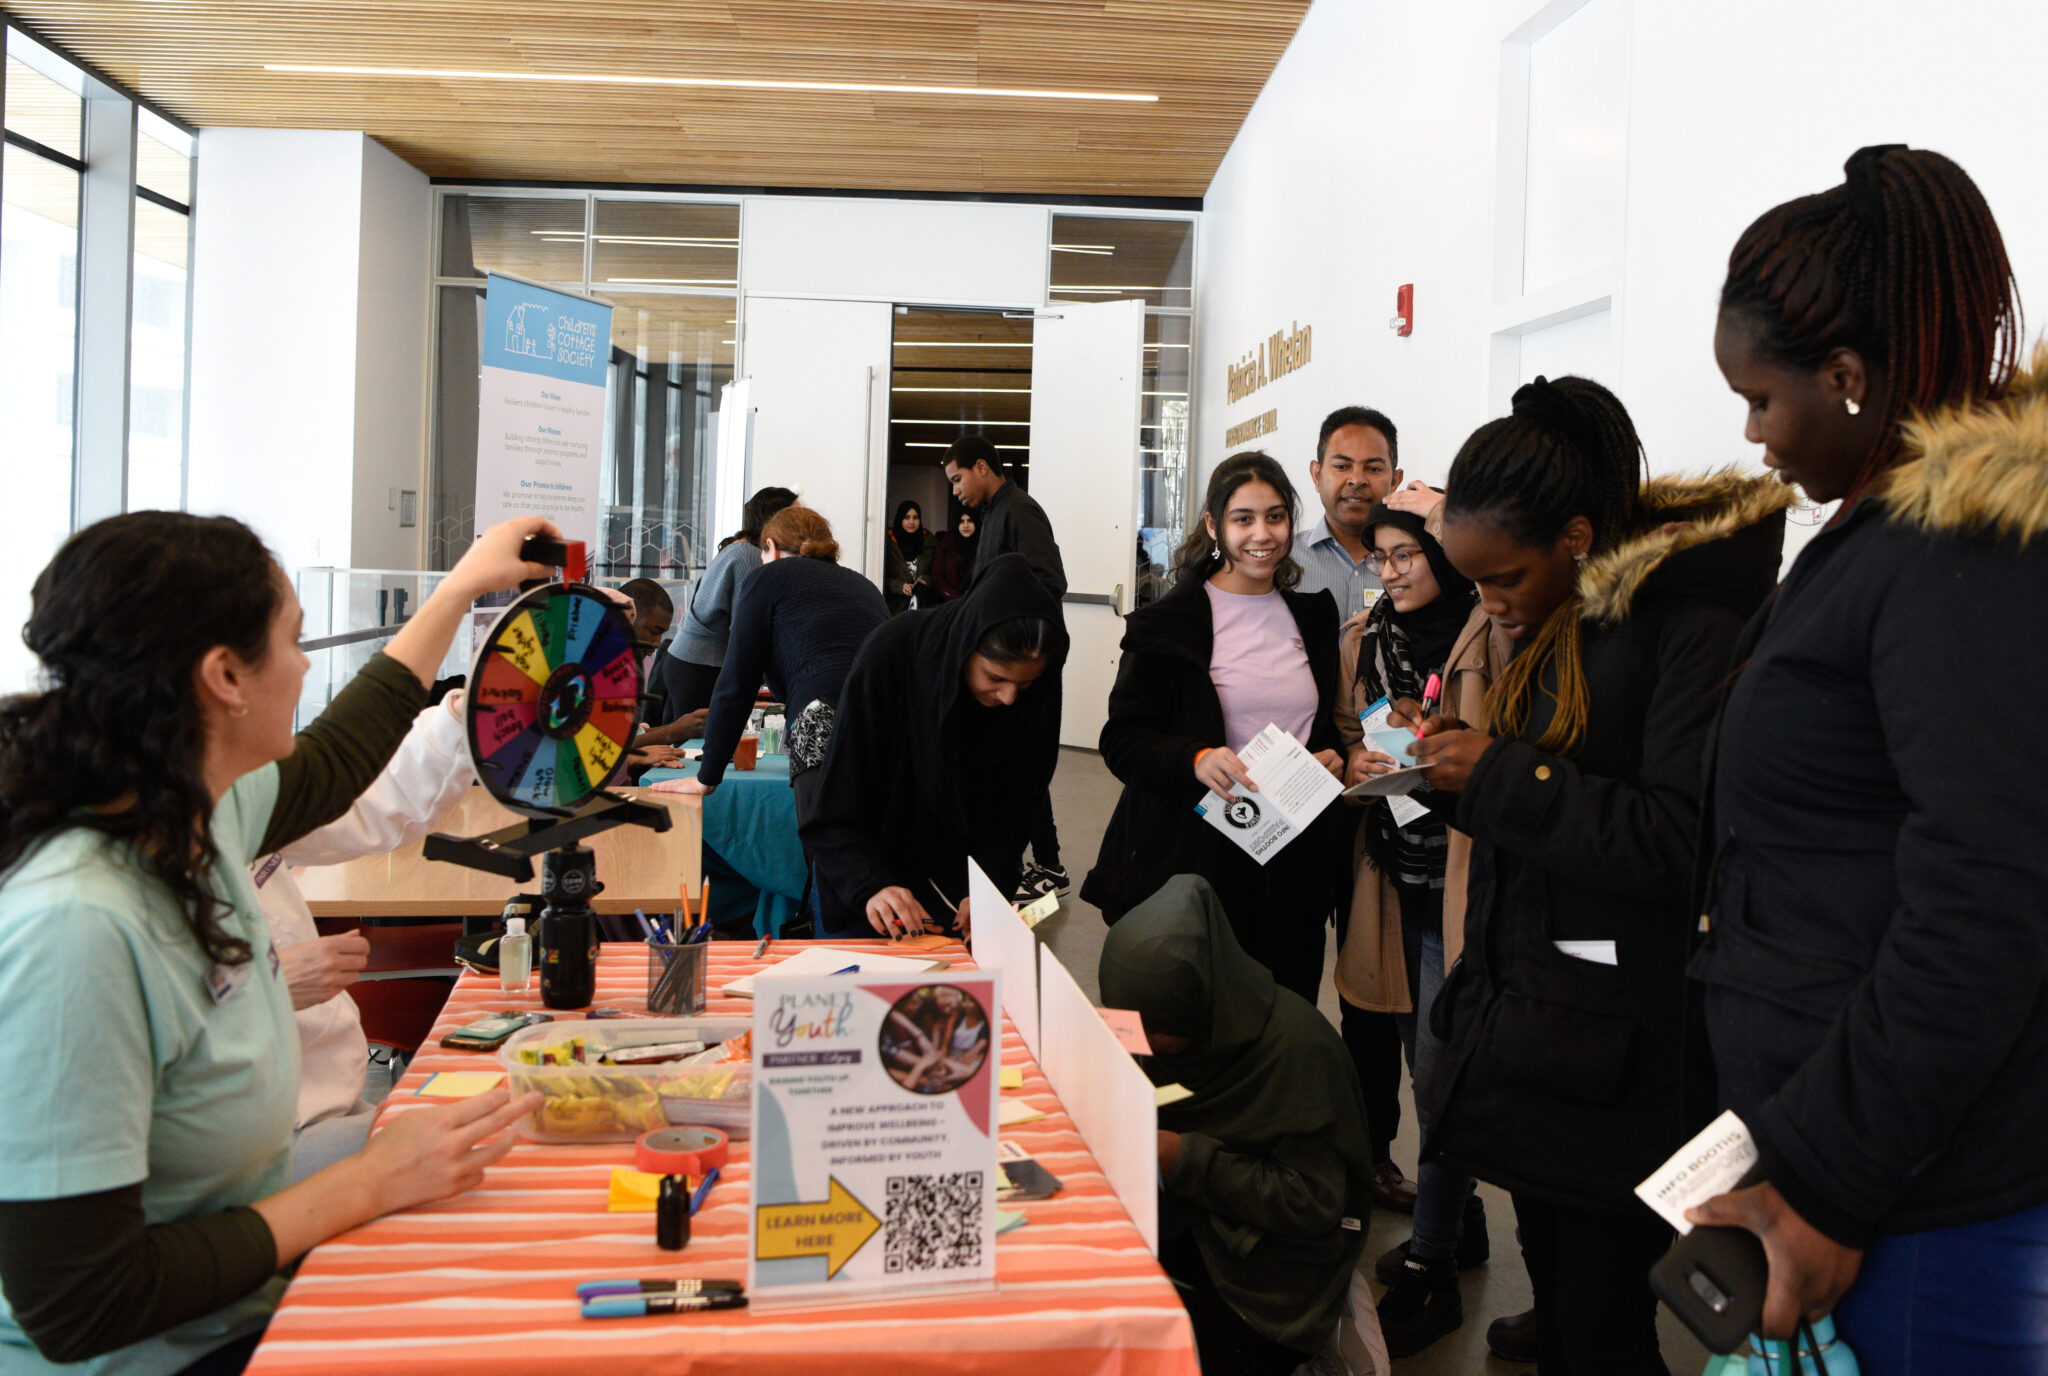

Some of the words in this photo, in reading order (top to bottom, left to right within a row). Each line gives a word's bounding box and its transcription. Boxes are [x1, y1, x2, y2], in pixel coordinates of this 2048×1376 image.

[1227, 351, 1256, 405] Patricia
[1269, 320, 1311, 382] Whelan
[1277, 824, 1291, 838] INFO
[1255, 834, 1279, 856] BOOTHS
[778, 990, 855, 1009] PLANET
[769, 1001, 854, 1048] Youth
[768, 1053, 818, 1065] PARTNER
[788, 1086, 833, 1096] TOGETHER
[830, 1106, 837, 1115] A
[840, 1105, 865, 1115] NEW
[868, 1102, 928, 1113] APPROACH
[929, 1101, 944, 1111] TO
[827, 1122, 876, 1132] IMPROVE
[879, 1118, 937, 1129] WELLBEING
[821, 1138, 861, 1149] DRIVEN
[864, 1136, 878, 1147] BY
[830, 1153, 886, 1165] INFORMED
[888, 1152, 902, 1162] BY
[905, 1150, 942, 1160] YOUTH
[1658, 1170, 1688, 1199] INFO
[1688, 1131, 1742, 1172] BOOTHS
[766, 1214, 816, 1230] LEARN
[820, 1211, 864, 1225] MORE
[796, 1233, 835, 1248] HERE
